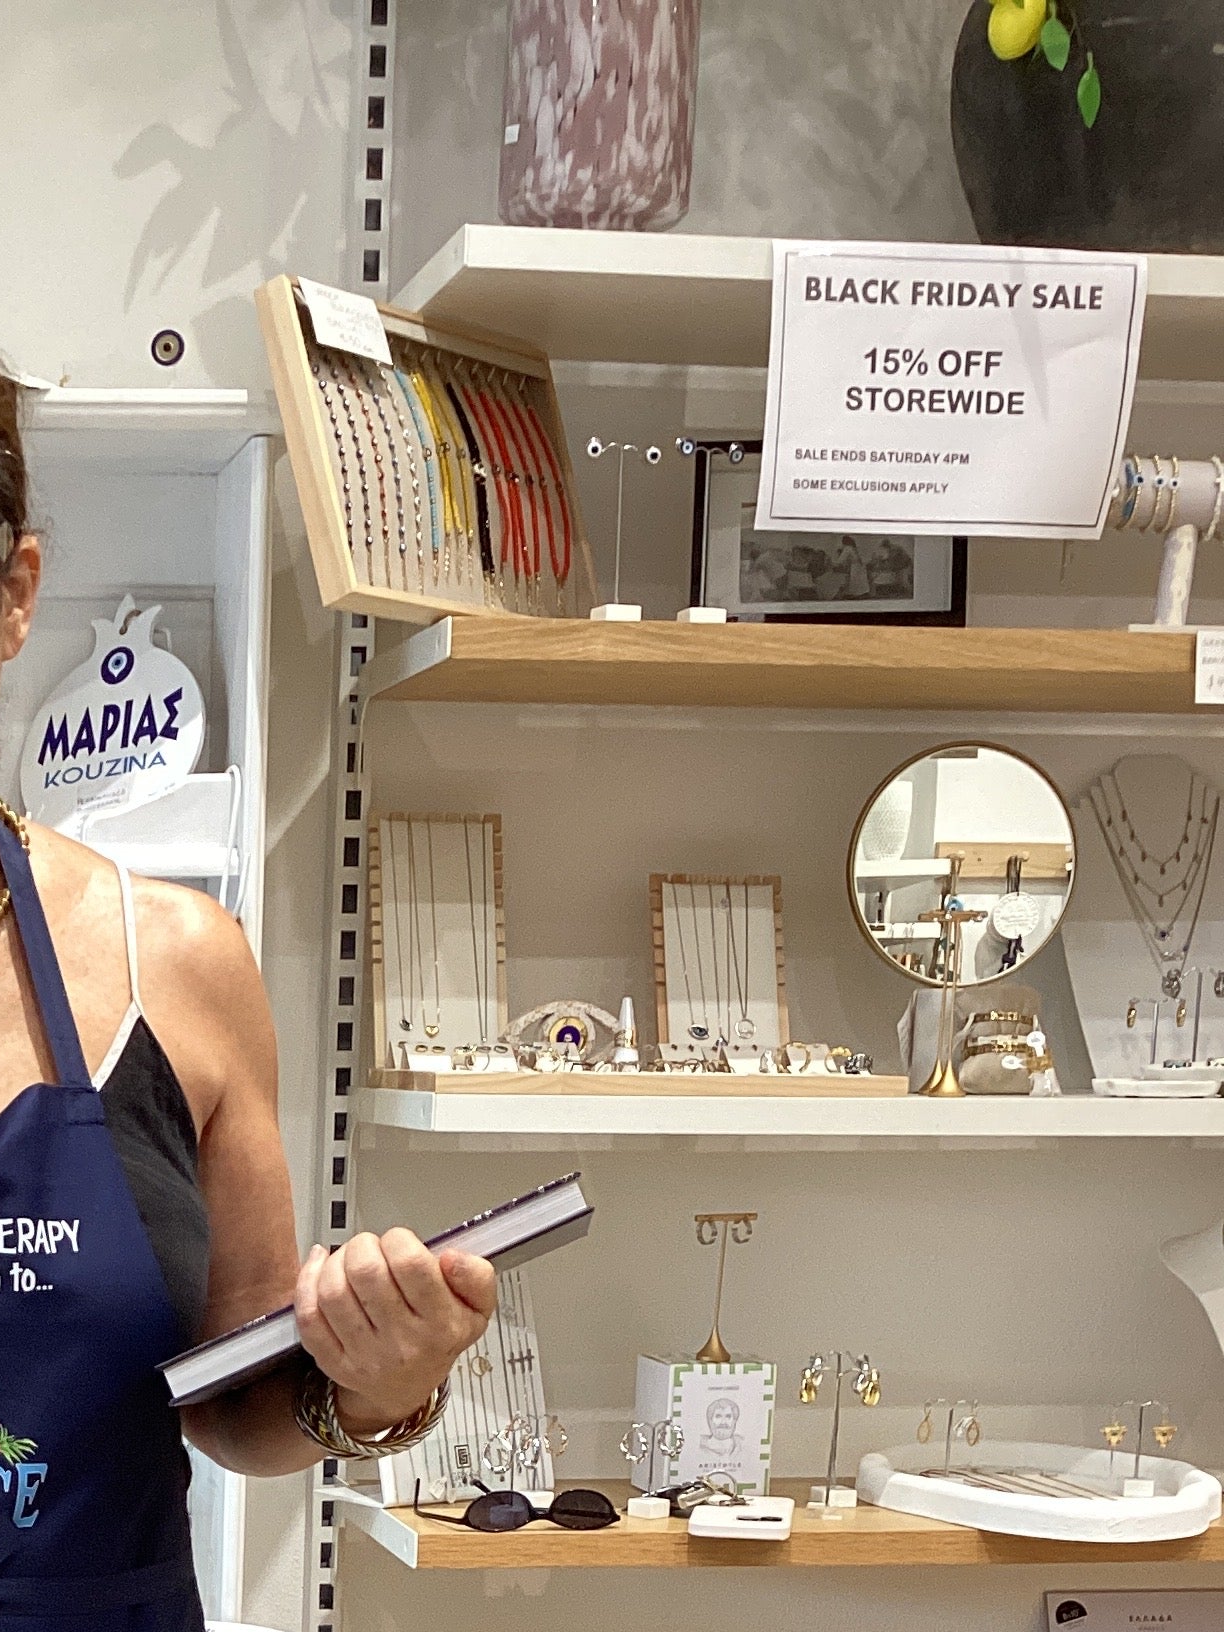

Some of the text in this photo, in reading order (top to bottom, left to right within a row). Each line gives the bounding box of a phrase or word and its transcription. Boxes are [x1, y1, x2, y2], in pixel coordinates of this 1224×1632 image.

[805, 276, 1104, 311] BLACK FRIDAY SALE
[863, 347, 1003, 378] 15% OFF
[845, 386, 1025, 415] STOREWIDE
[794, 448, 970, 465] SALE ENDS SATURDAY 4PM
[793, 478, 949, 494] SOME EXCLUSIONS APPLY
[37, 687, 183, 766] ΜΑΡΙΑΣ
[44, 751, 167, 789] KOUZINA
[10, 1261, 54, 1292] to...
